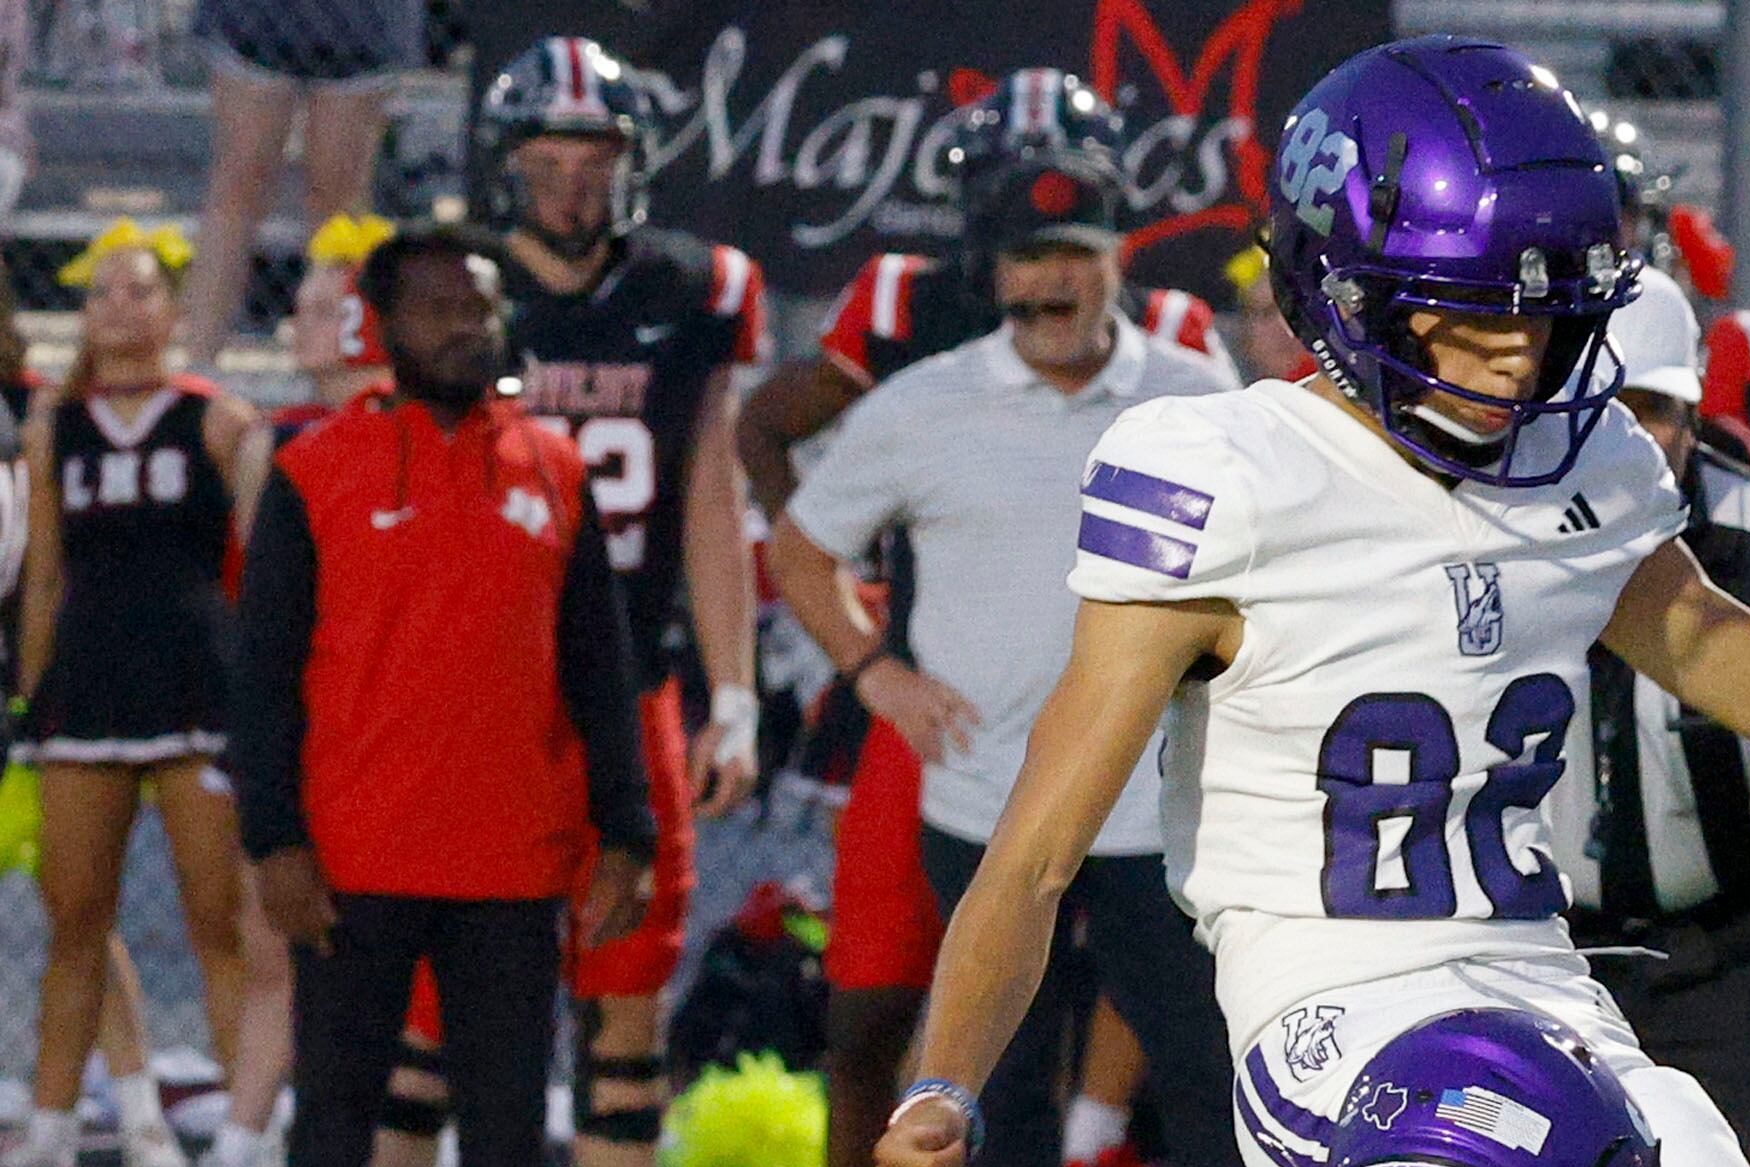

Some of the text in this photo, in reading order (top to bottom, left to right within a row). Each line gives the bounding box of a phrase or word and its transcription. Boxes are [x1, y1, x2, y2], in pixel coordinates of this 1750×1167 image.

[632, 26, 1252, 247] Majecs
[1280, 107, 1359, 237] 82
[535, 415, 656, 571] 2
[1316, 672, 1576, 921] 82
